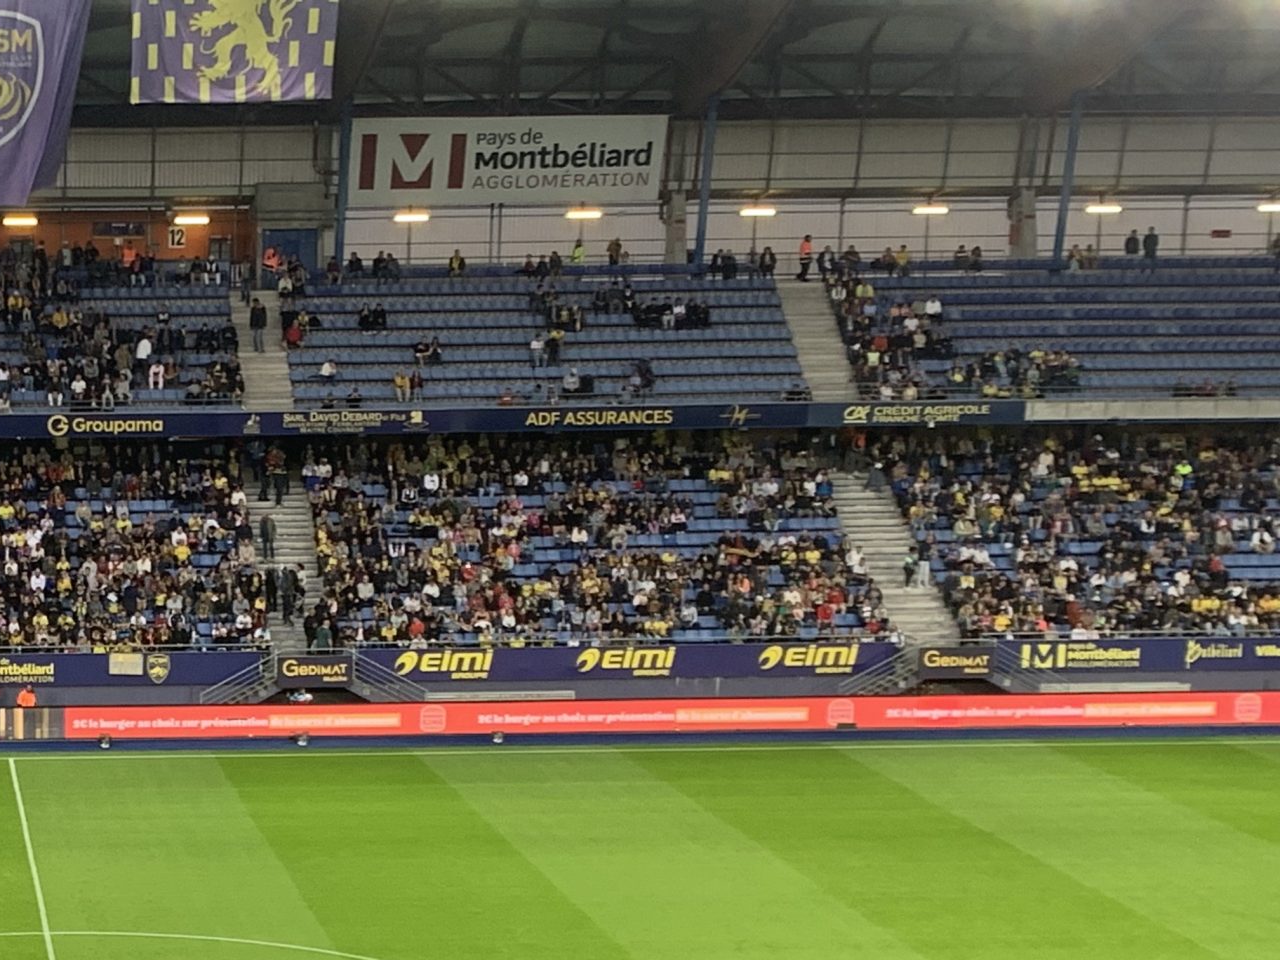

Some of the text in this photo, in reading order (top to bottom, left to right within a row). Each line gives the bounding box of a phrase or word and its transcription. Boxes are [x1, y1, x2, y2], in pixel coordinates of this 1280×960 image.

[519, 127, 543, 145] de
[475, 141, 653, 170] Montbéliard
[472, 170, 651, 190] AGGLOMÉRATION
[169, 229, 185, 246] 12
[525, 408, 673, 426] ADF ASSURANCES
[923, 405, 990, 415] AGRICOLE
[72, 418, 164, 435] Groupama
